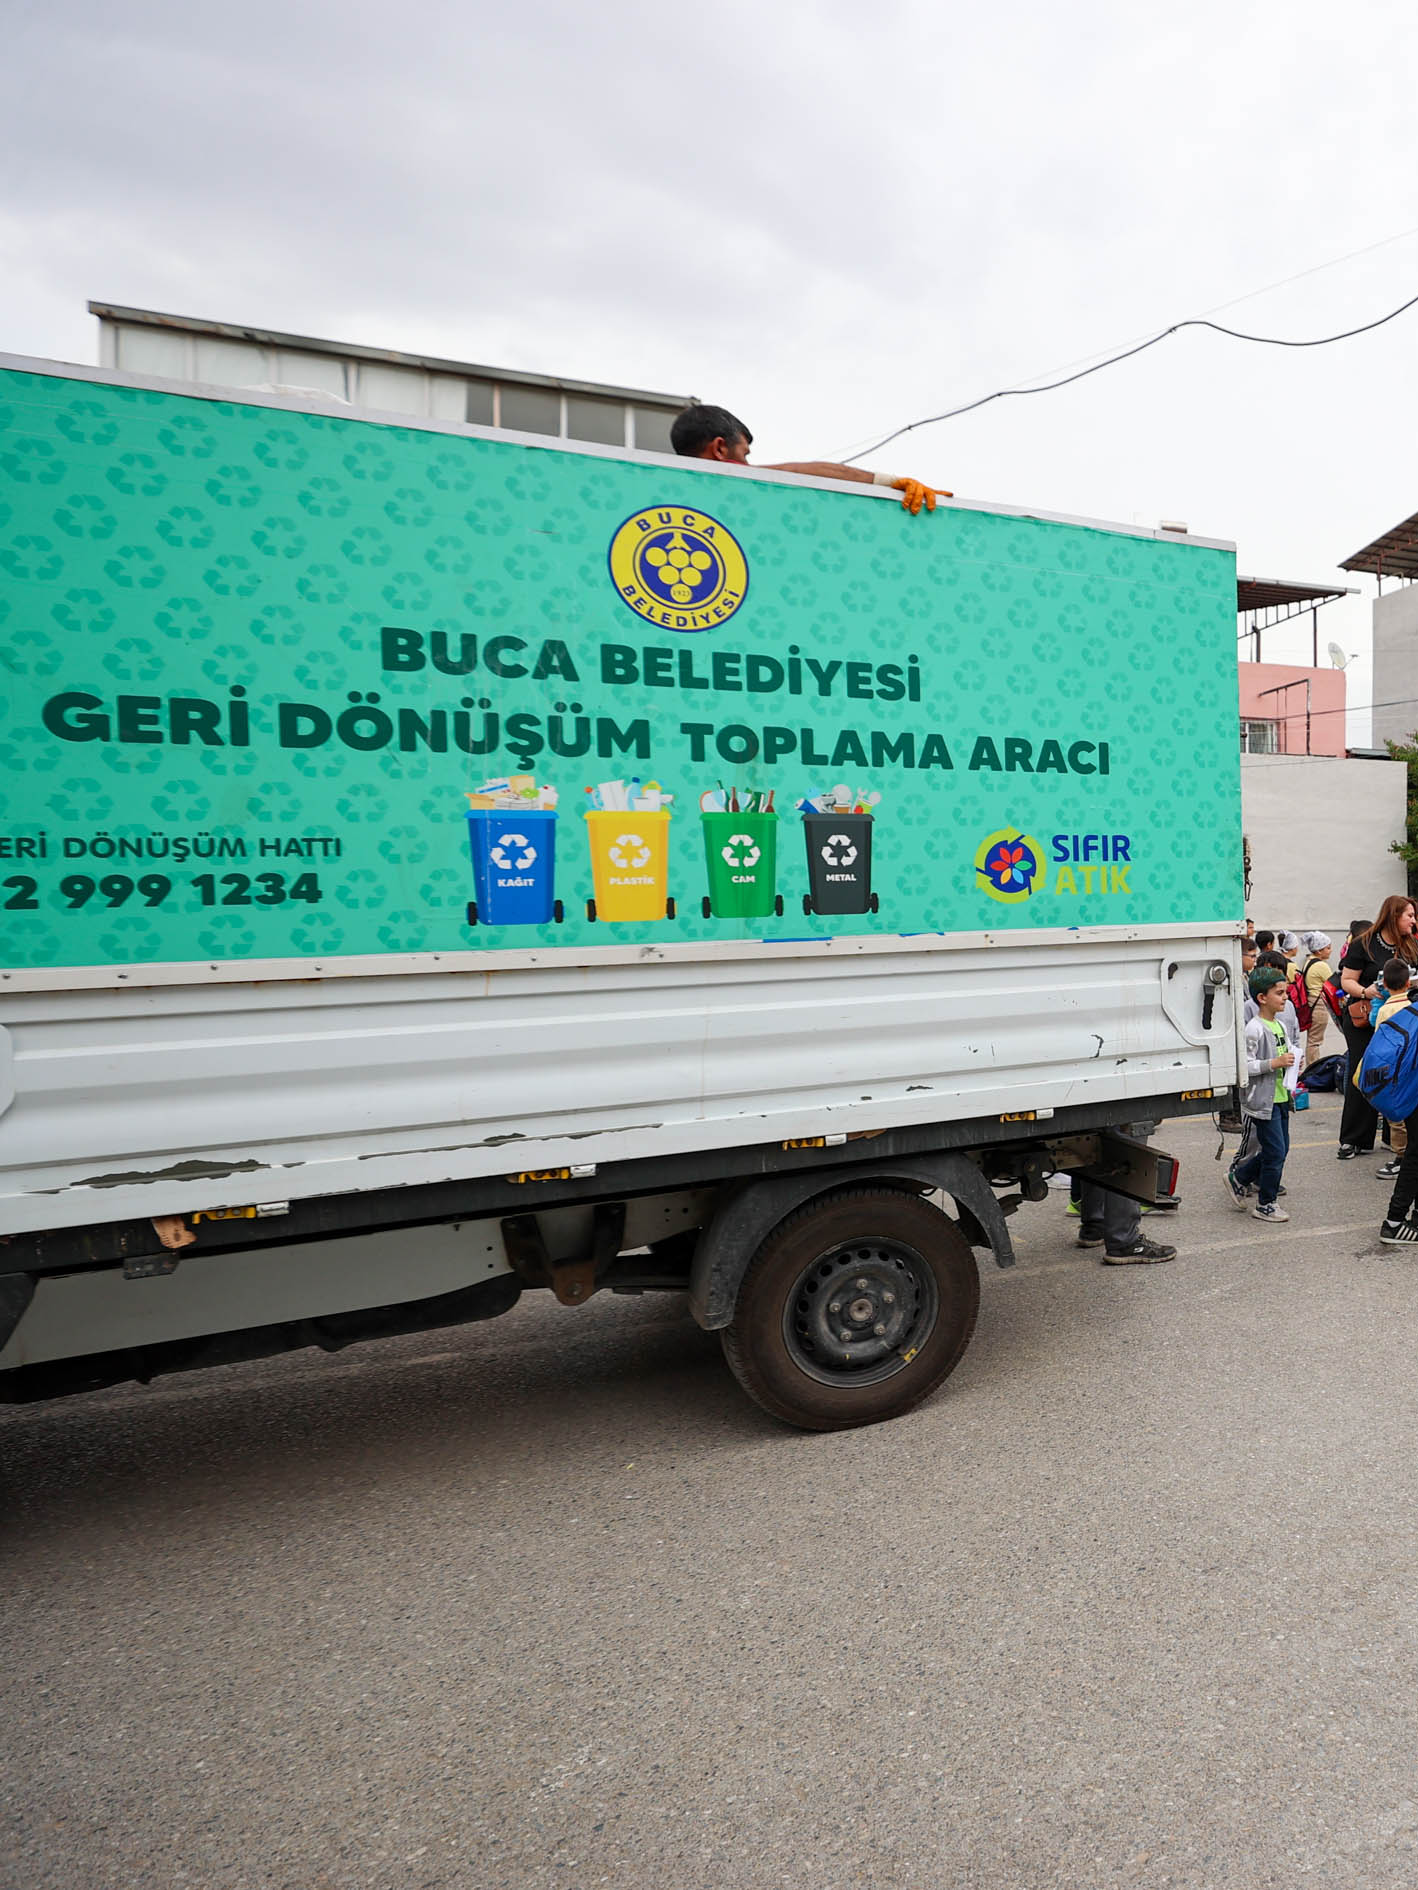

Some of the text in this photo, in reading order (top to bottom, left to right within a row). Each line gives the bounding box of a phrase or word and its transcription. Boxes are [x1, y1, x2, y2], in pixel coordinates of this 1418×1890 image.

[636, 511, 716, 539] BUCA
[622, 585, 740, 627] BELEDİYESİ
[381, 626, 921, 702] BUCA BELEDİYESİ
[41, 684, 1111, 775] GERİ DÖNÜŞÜM TOPLAMA ARACI
[63, 831, 247, 863] DÖNÜŞÜM
[259, 836, 342, 859] HATTI
[1051, 834, 1132, 863] SIFIR
[2, 872, 323, 911] 2 999 1234
[497, 876, 535, 888] KAĞIT
[608, 876, 655, 886] PLASTİK
[731, 875, 756, 884] CAM
[825, 874, 857, 882] METAL
[1055, 865, 1133, 895] ATIK
